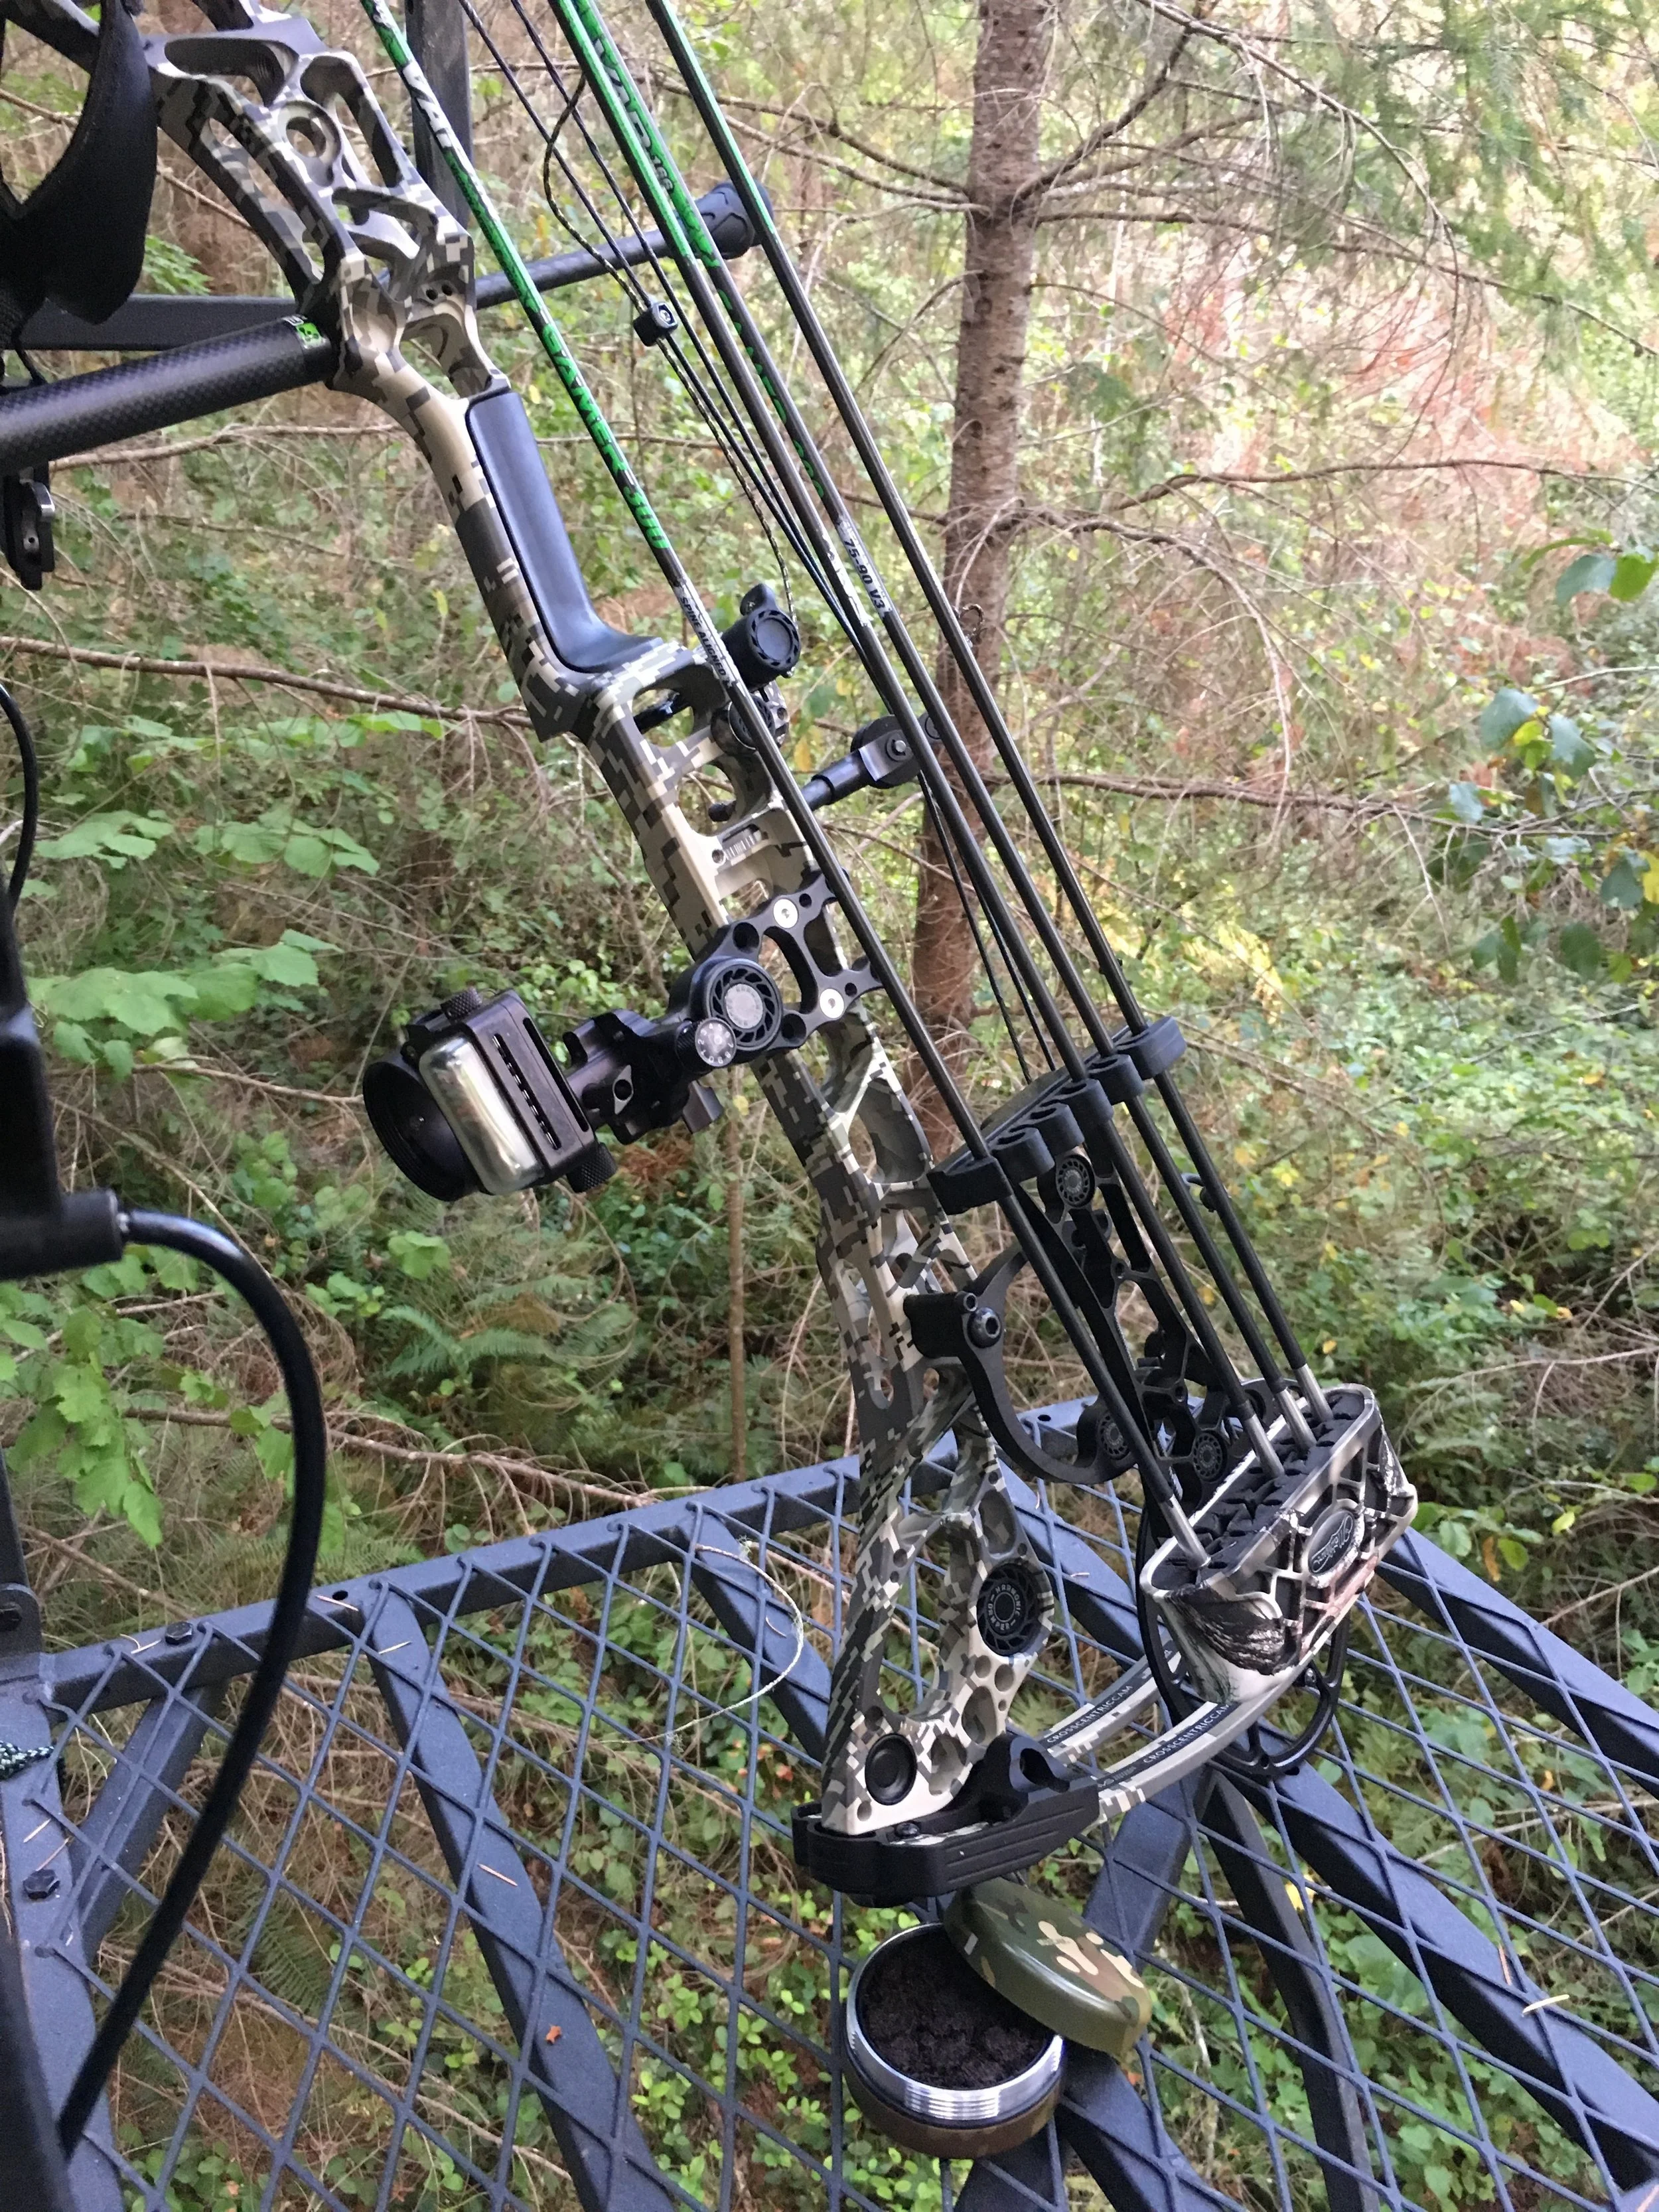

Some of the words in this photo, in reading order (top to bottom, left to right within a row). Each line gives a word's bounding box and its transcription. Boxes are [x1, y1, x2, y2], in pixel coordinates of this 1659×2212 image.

[540, 323, 629, 473] GAMER
[622, 485, 670, 550] 300
[843, 537, 873, 586] 75-90
[868, 587, 886, 610] V3
[679, 595, 701, 628] SPINE
[697, 628, 727, 677] ALIGNED
